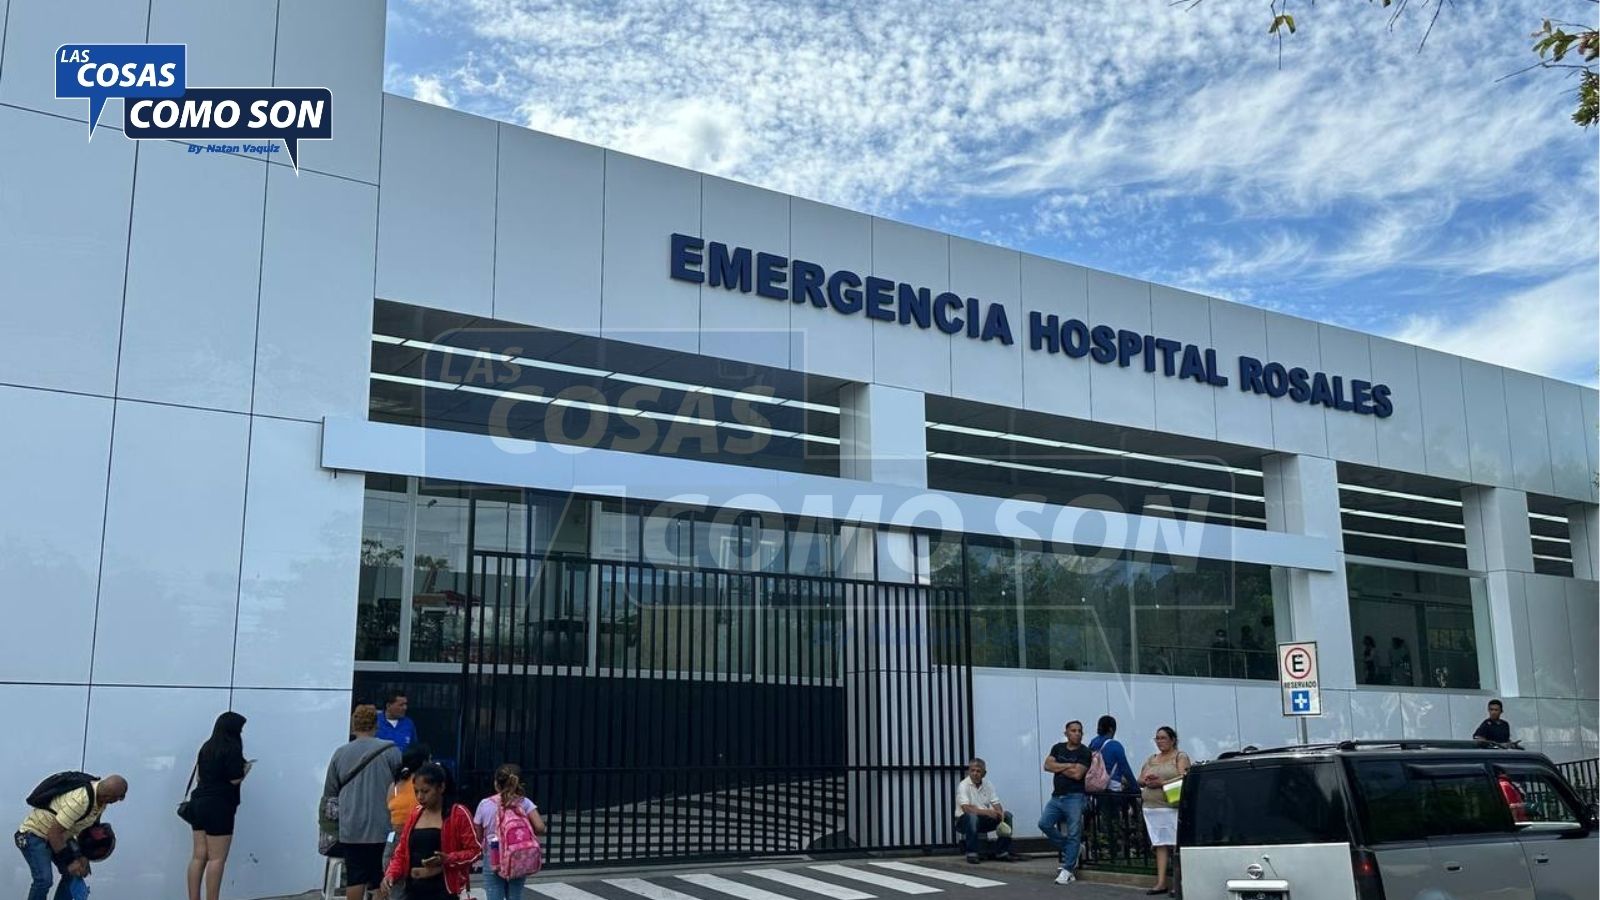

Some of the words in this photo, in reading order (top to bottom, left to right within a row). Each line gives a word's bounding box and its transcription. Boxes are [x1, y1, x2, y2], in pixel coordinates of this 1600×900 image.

[670, 233, 1014, 345] EMERGENCIA
[1029, 311, 1228, 387] HOSPITAL
[1239, 356, 1393, 418] ROSALES
[1292, 654, 1304, 672] E
